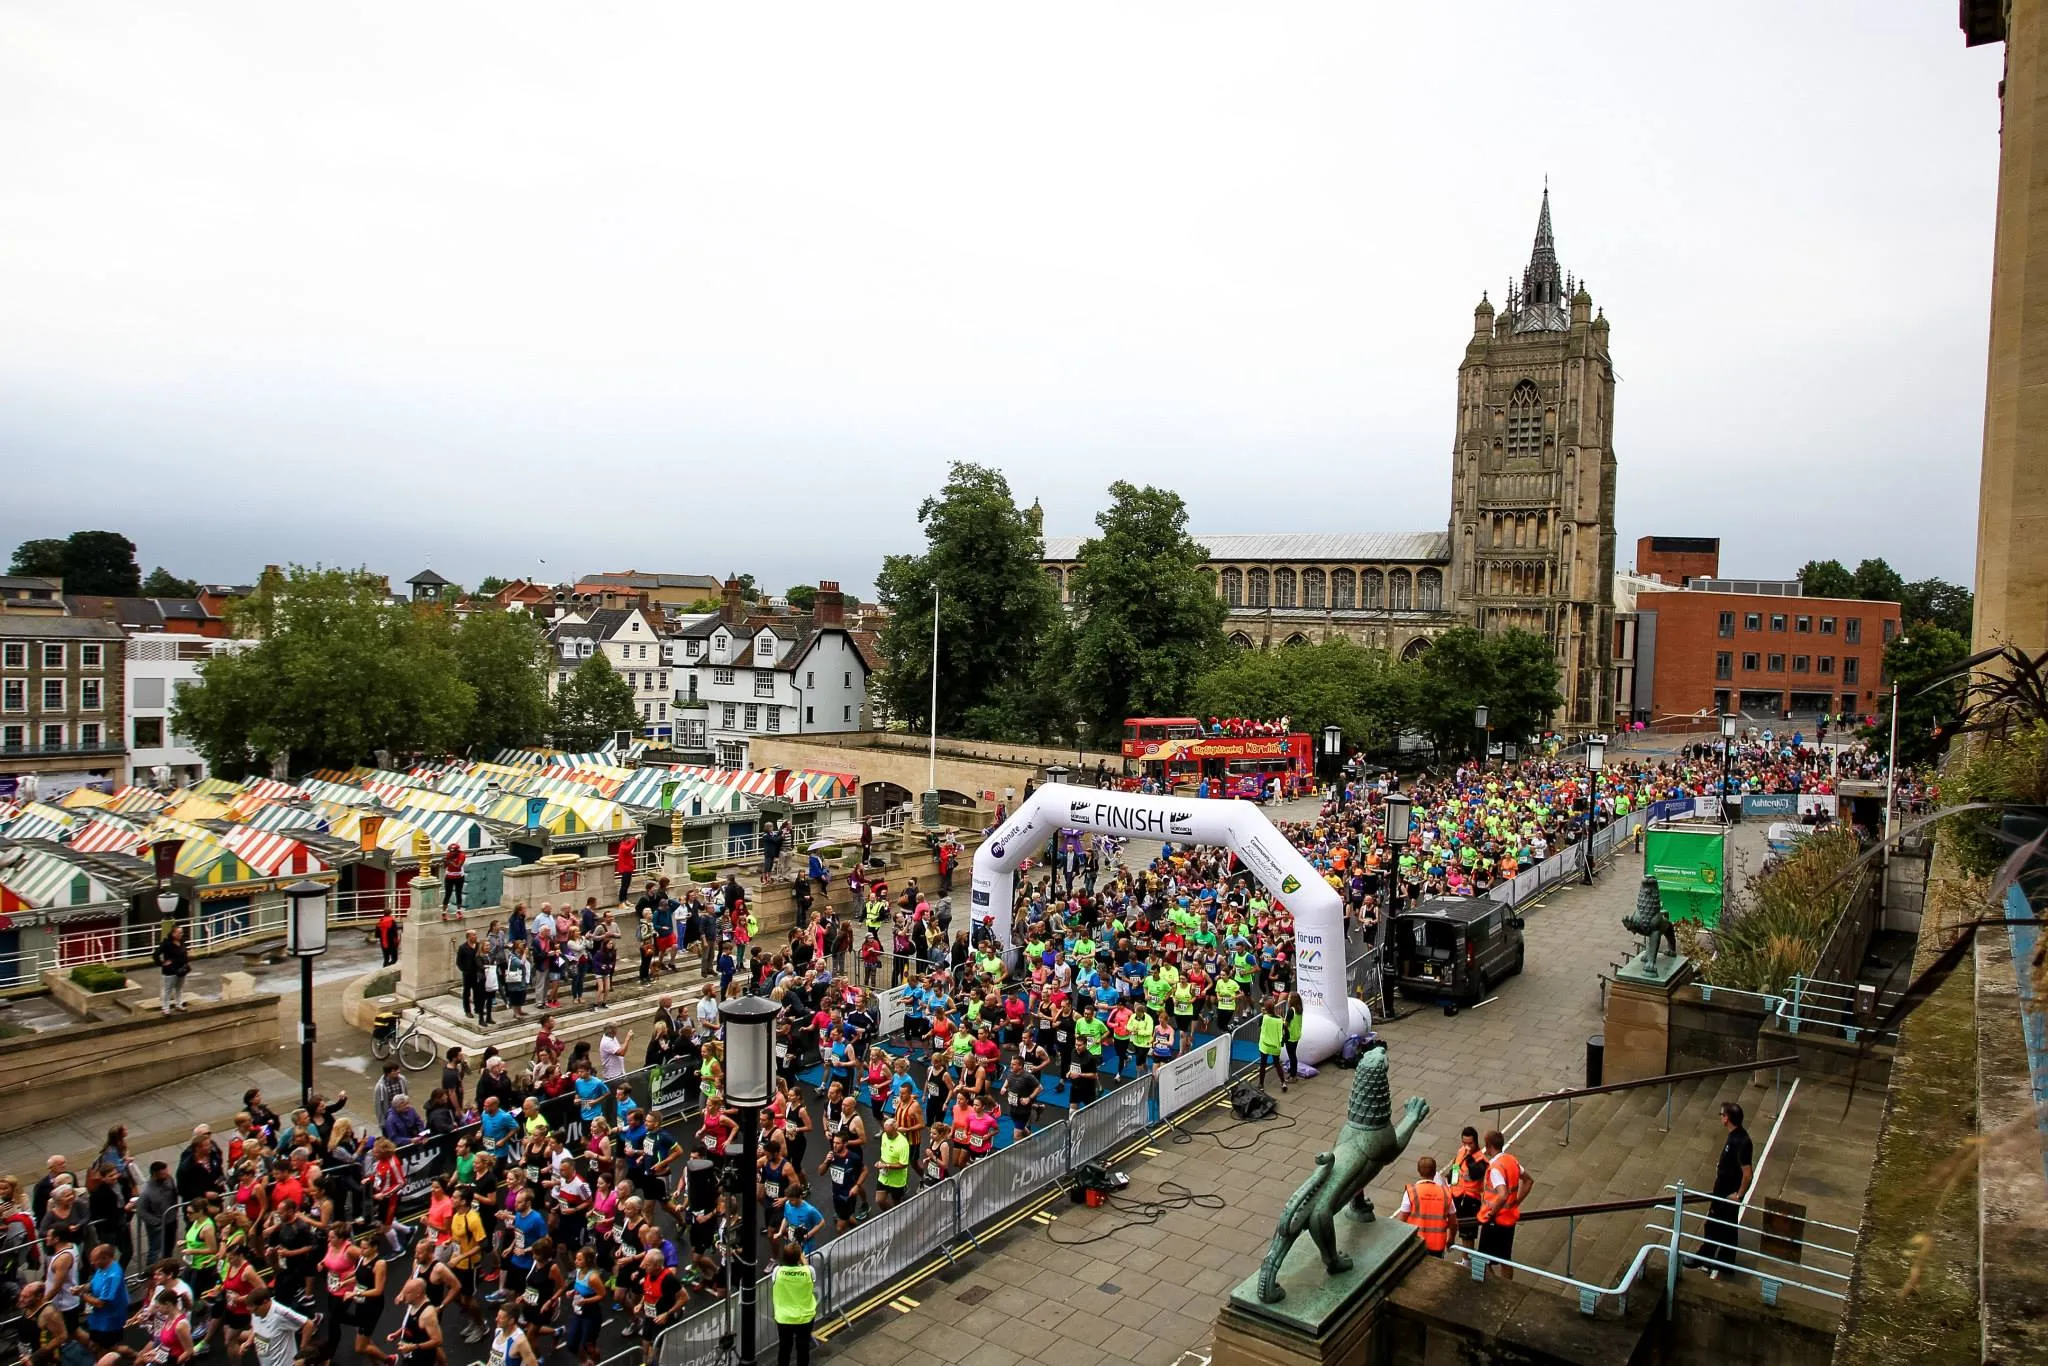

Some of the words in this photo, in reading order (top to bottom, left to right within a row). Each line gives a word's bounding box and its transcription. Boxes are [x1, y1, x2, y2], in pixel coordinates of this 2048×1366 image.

[1246, 742, 1280, 754] Norwich
[665, 786, 673, 796] B
[531, 802, 541, 813] C
[1095, 804, 1164, 833] FINISH
[365, 822, 376, 835] D
[160, 847, 171, 860] E
[652, 1088, 685, 1104] NORWICH
